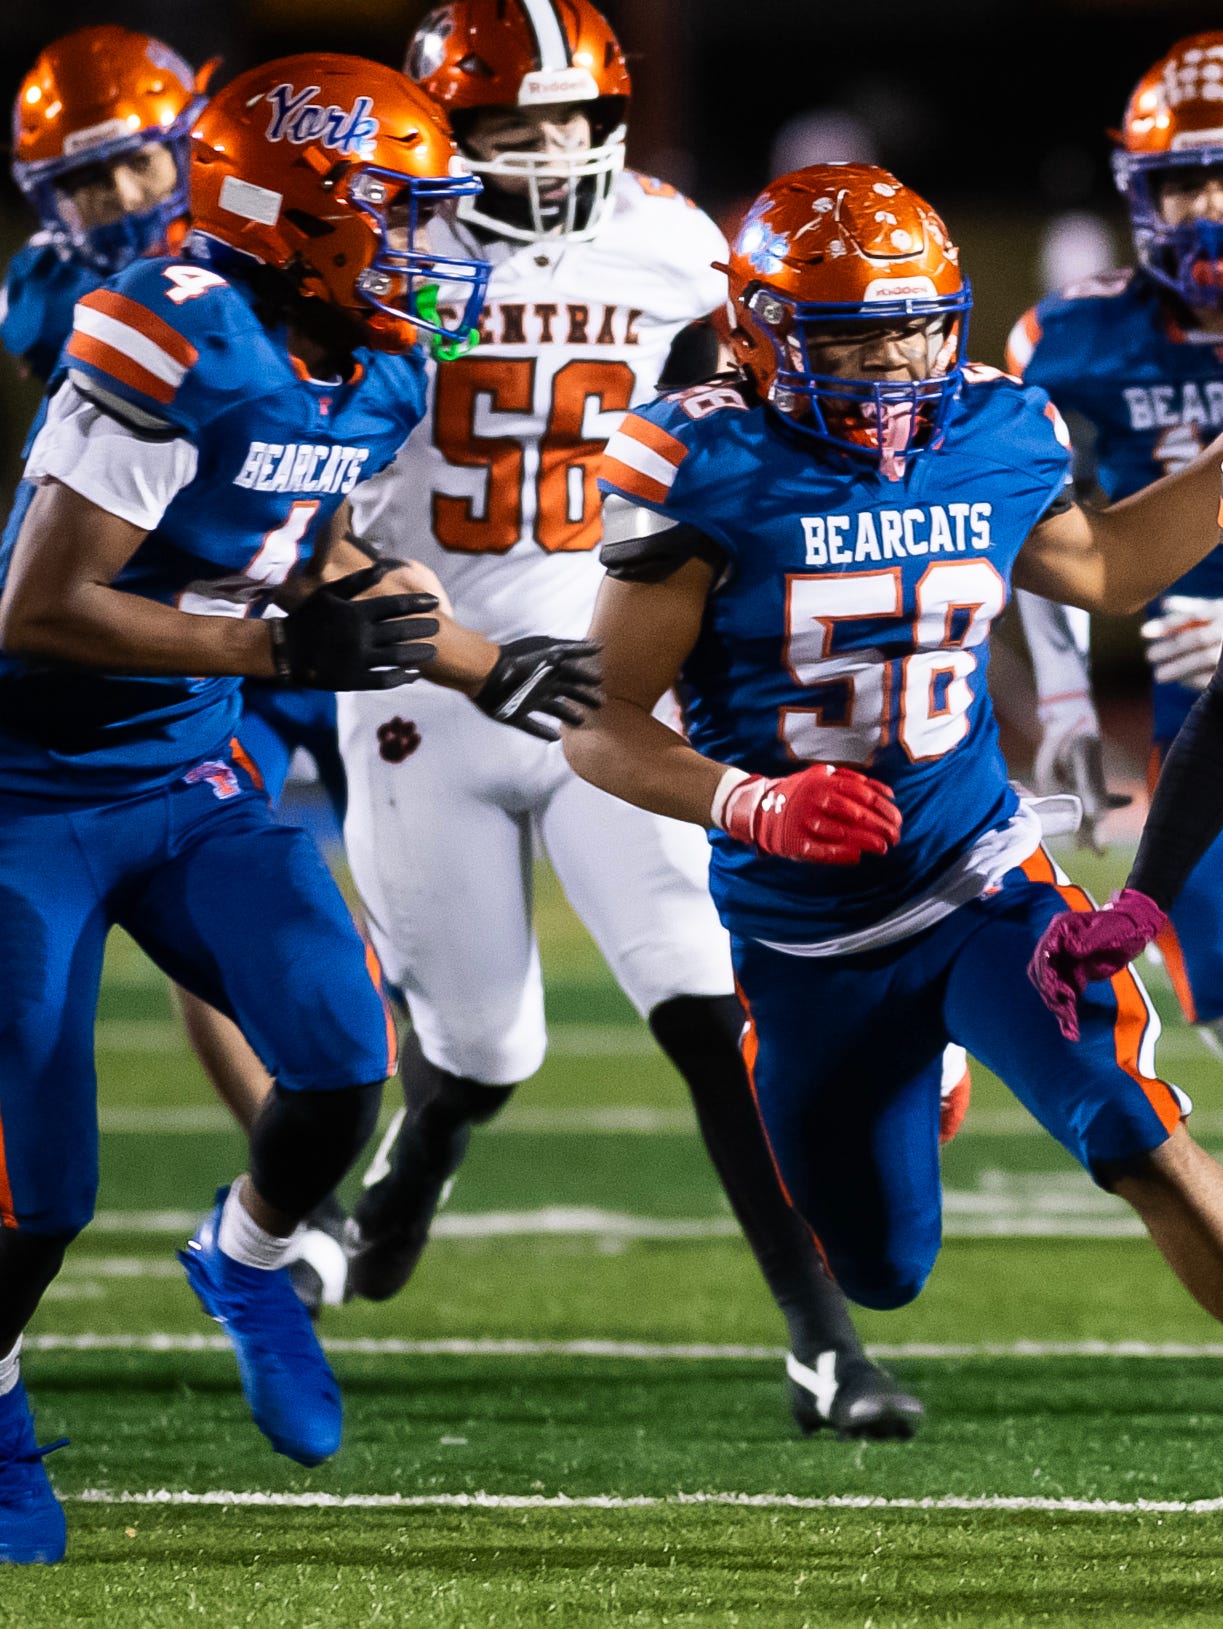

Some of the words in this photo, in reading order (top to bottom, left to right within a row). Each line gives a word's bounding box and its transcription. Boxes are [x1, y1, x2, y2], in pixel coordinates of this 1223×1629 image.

[265, 83, 379, 160] York
[162, 265, 231, 306] 4
[232, 441, 370, 494] BEARCATS
[430, 356, 637, 555] 56
[801, 502, 992, 567] BEARCATS
[778, 557, 1006, 767] 58
